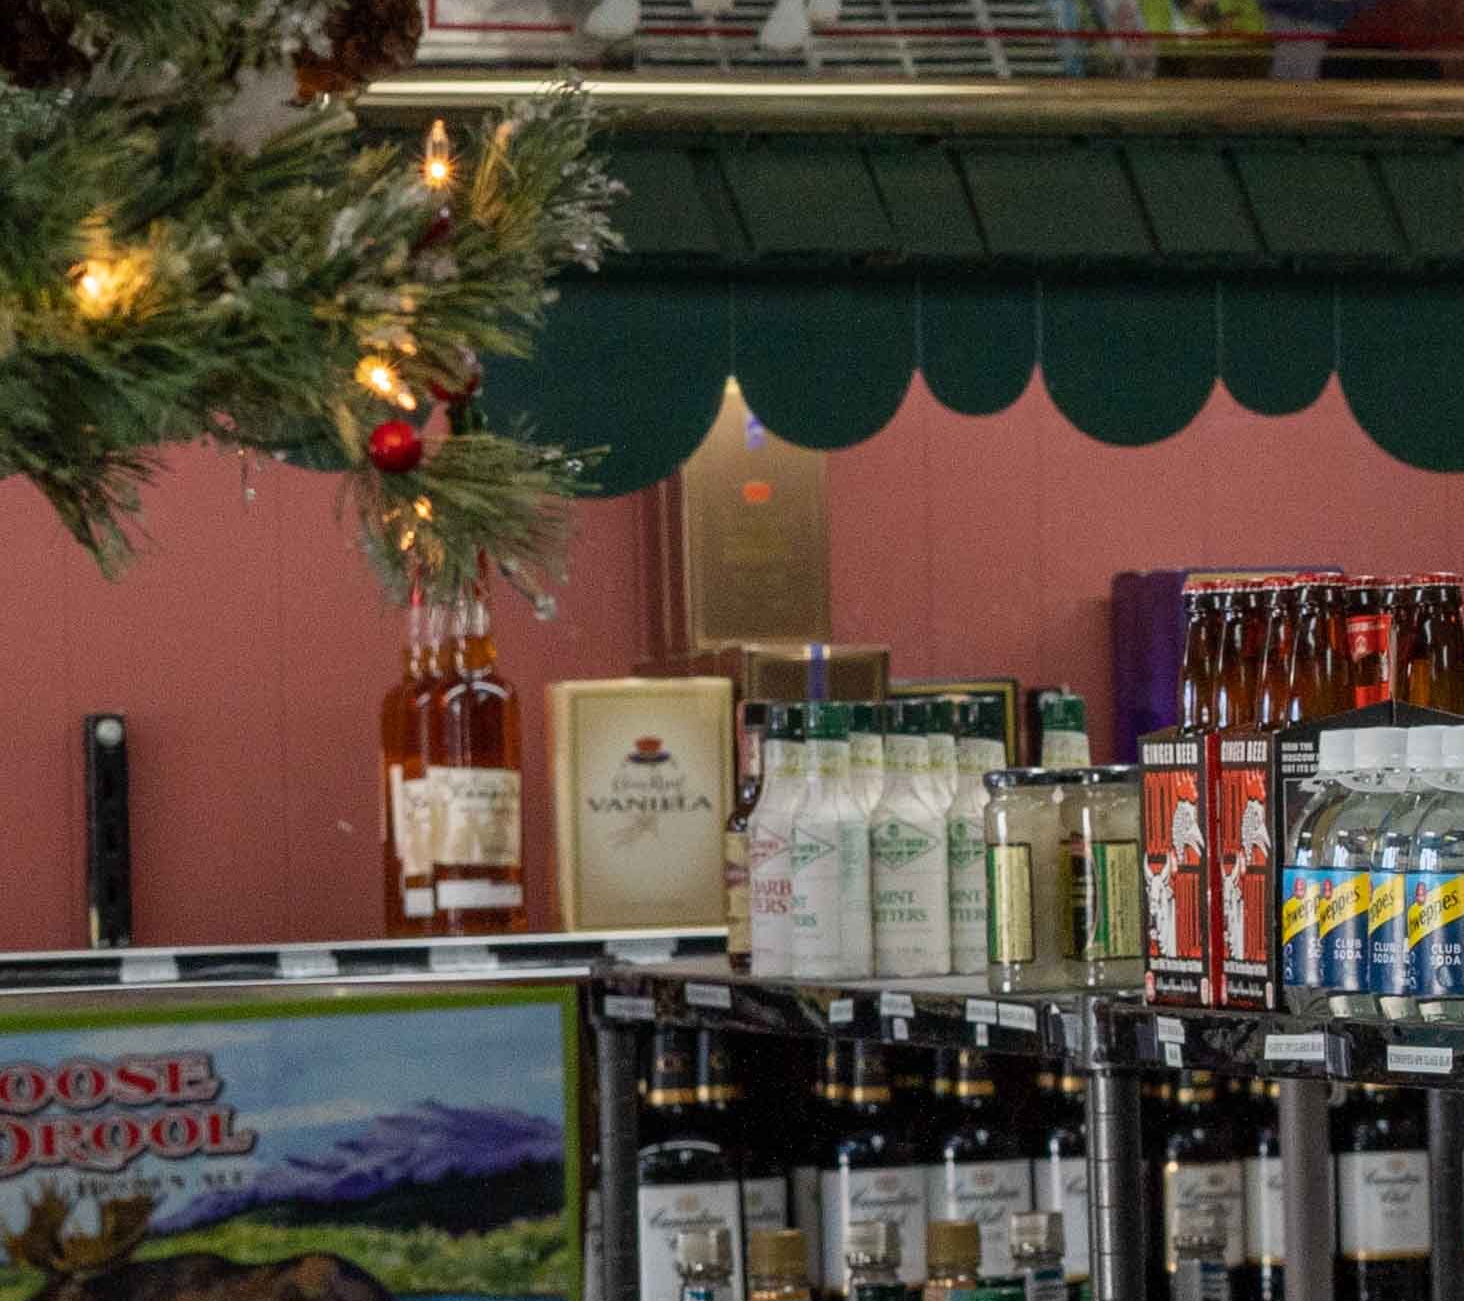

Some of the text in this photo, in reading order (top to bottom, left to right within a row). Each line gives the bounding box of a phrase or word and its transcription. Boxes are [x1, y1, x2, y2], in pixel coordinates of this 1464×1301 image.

[1144, 743, 1198, 764] GINGER BEER
[1431, 943, 1461, 955] CLUB
[1429, 955, 1462, 967] SODA
[0, 1050, 222, 1114] OOSE
